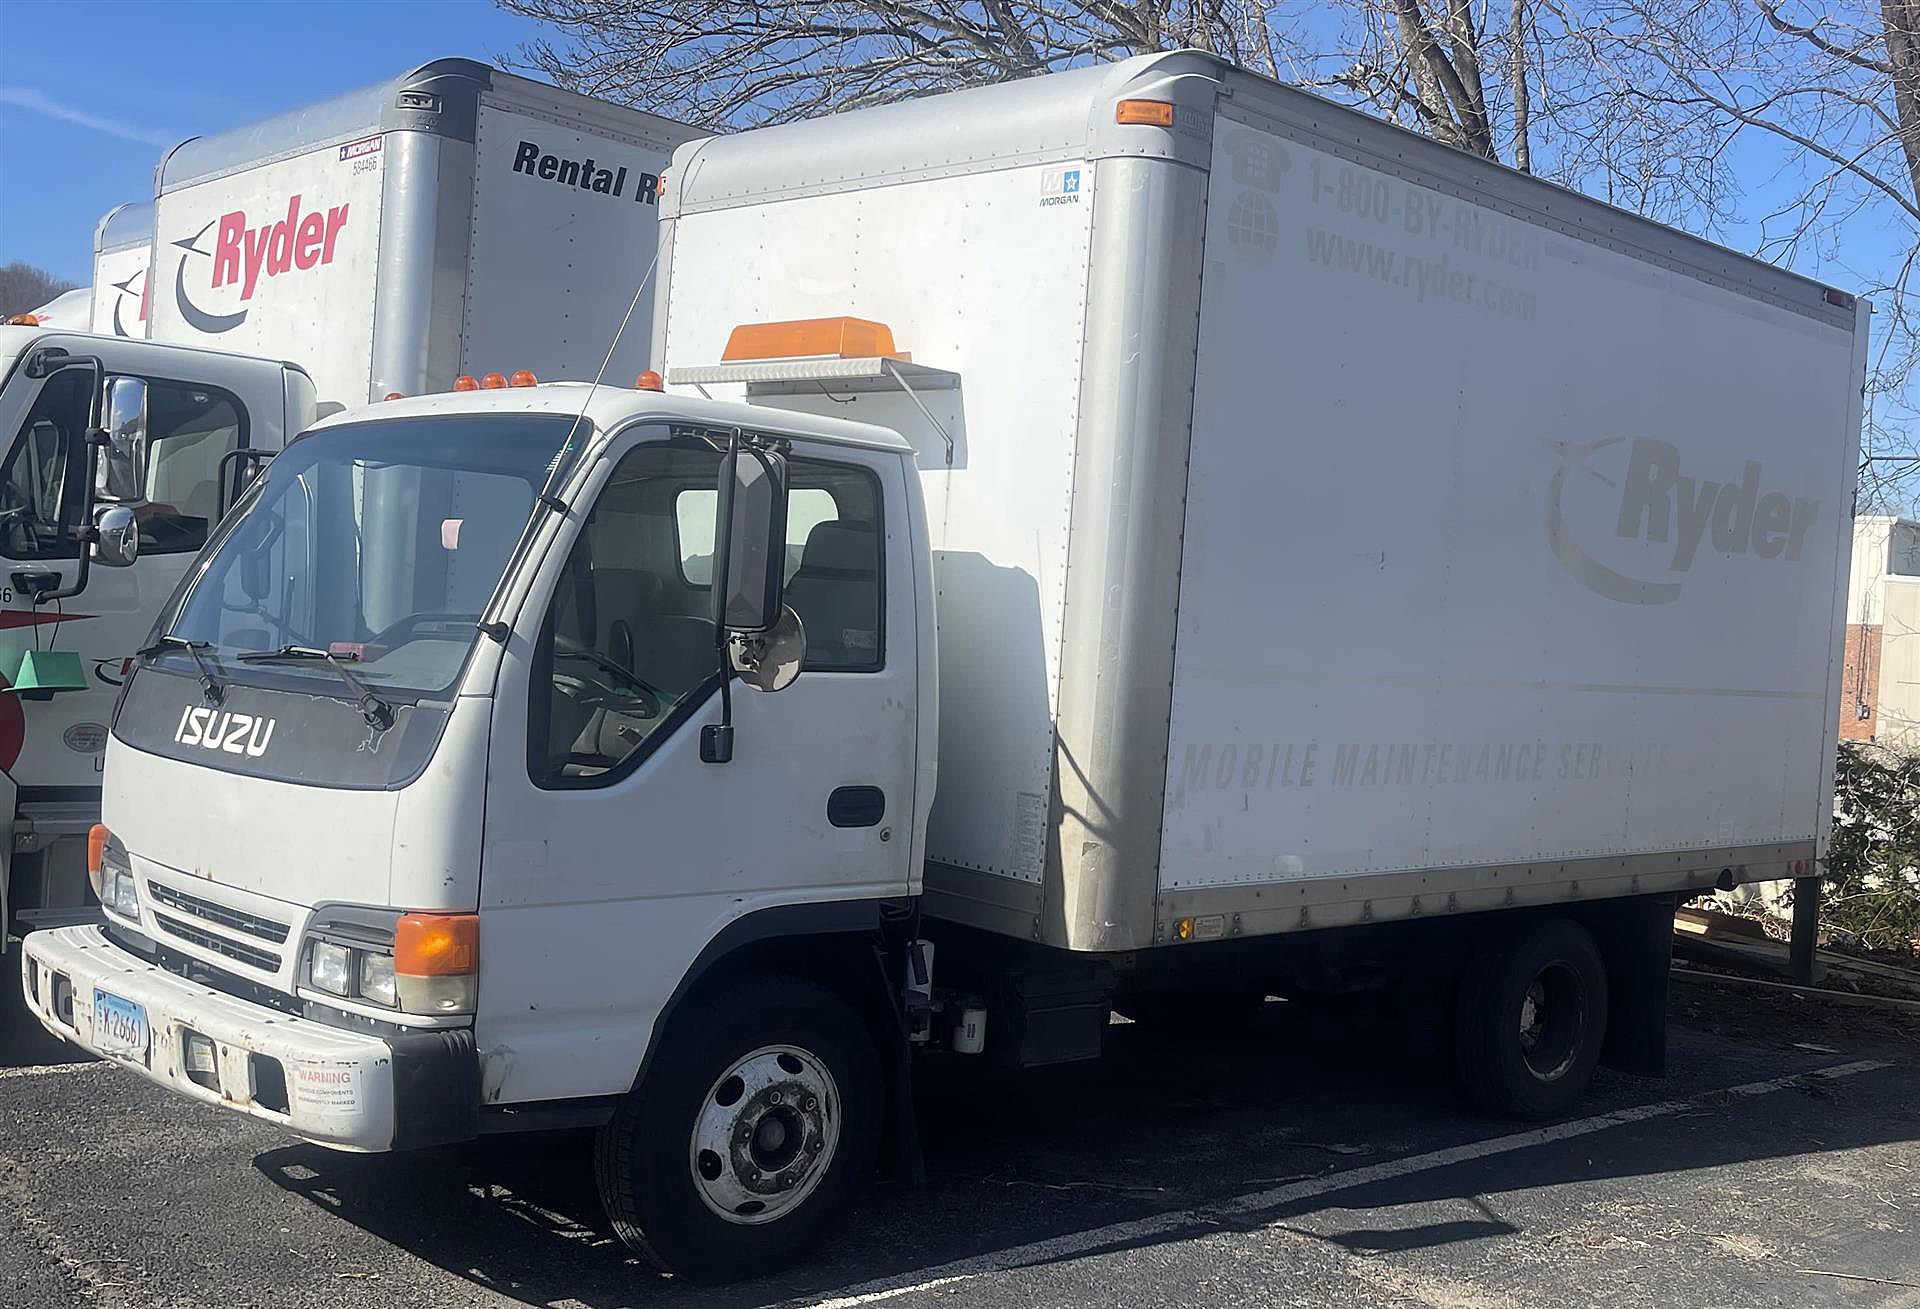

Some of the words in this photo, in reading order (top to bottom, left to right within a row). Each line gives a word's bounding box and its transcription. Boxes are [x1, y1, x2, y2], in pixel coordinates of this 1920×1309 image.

[346, 138, 382, 158] MORGAN
[512, 140, 627, 198] Rental
[1039, 194, 1079, 207] MORGAN
[211, 194, 350, 302] Ryder
[1305, 224, 1536, 321] www.ryder.com
[1615, 437, 1822, 573] Ryder
[174, 704, 276, 758] ISUZU
[1180, 742, 1317, 789] MOBILE
[1331, 743, 1548, 787] MAINTENANCE
[299, 1070, 351, 1084] WARNING
